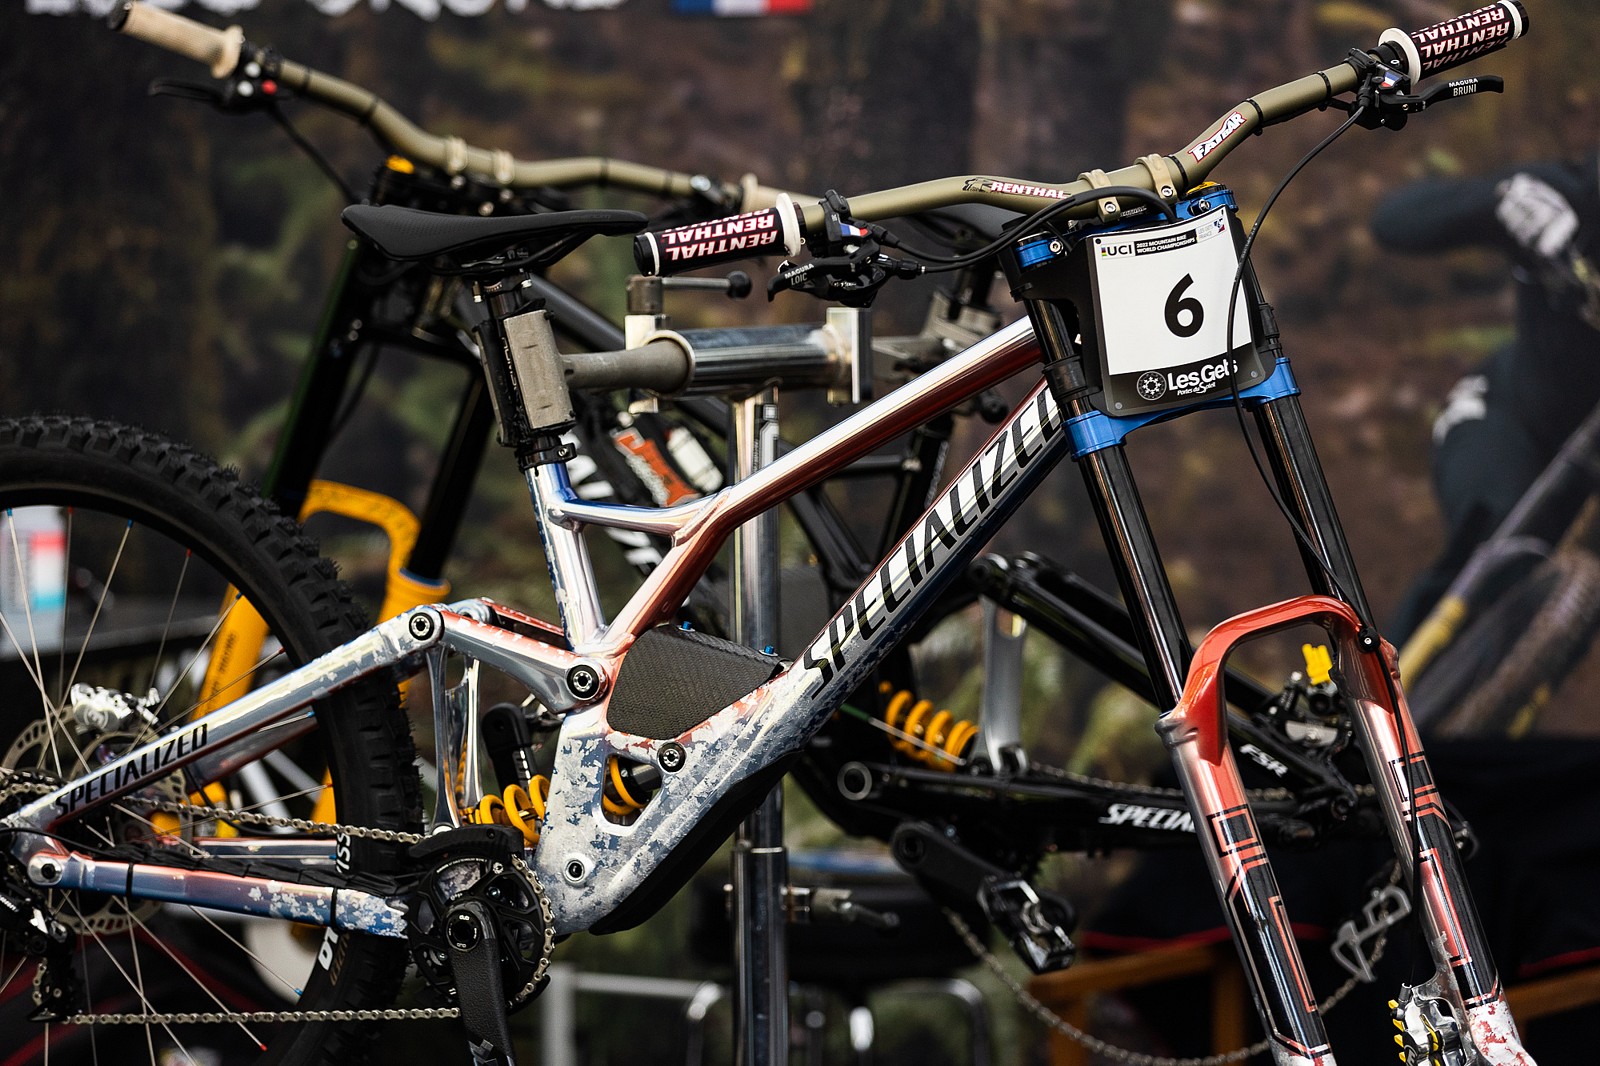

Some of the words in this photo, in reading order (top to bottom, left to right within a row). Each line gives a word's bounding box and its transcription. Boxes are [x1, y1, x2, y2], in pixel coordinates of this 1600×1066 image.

[1412, 8, 1505, 43] RENTHAL
[1421, 21, 1510, 58] RENTHAL
[1448, 78, 1479, 88] MAGURA
[1453, 84, 1477, 97] BRUNI
[1187, 111, 1247, 163] FATBAR
[990, 181, 1068, 200] RENTHAL
[662, 214, 775, 245] RENTHAL
[1149, 237, 1176, 246] MOUNTAIN
[666, 230, 778, 261] RENTHAL
[1107, 244, 1132, 256] UCI
[1137, 245, 1156, 253] WORLD
[784, 263, 815, 279] MAGURA
[1164, 273, 1205, 337] 6
[1167, 371, 1200, 391] Les
[56, 723, 208, 819] SPECIALIZED
[336, 833, 351, 874] ISS
